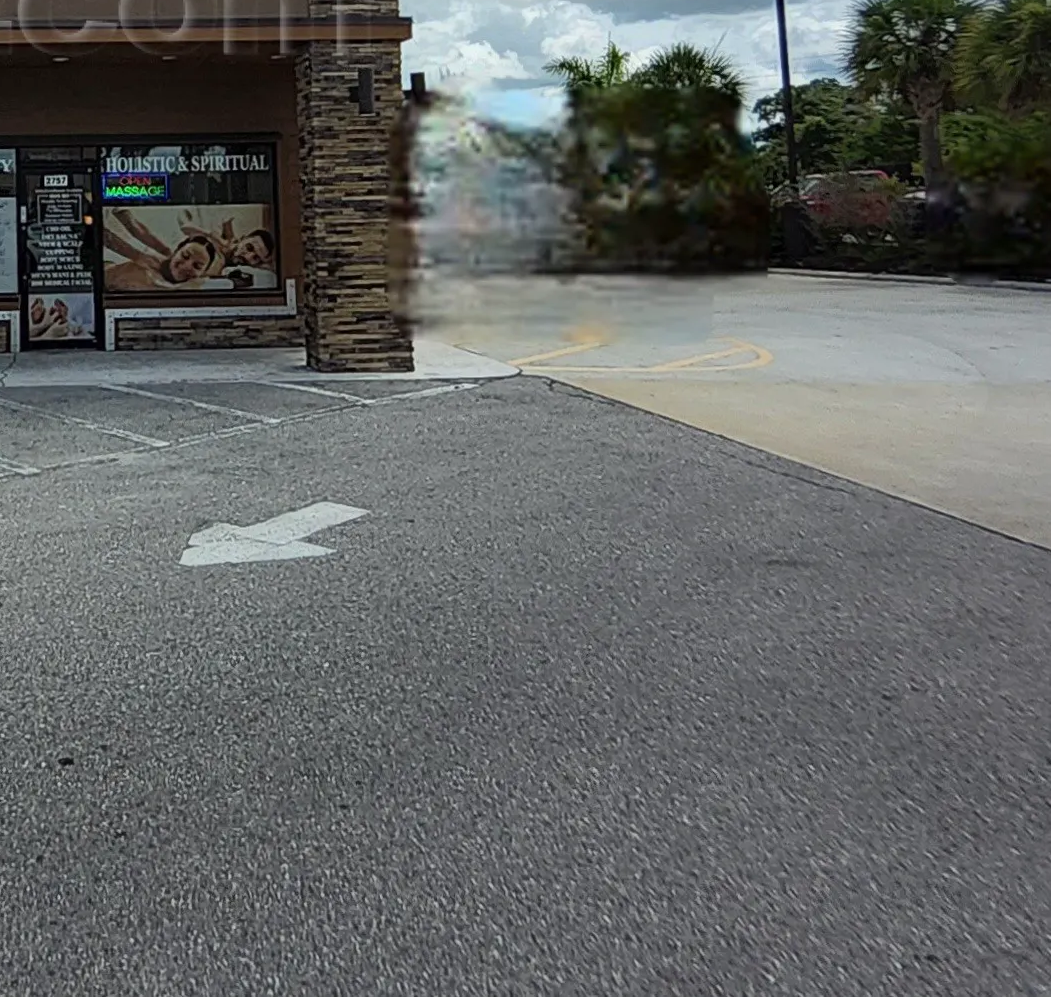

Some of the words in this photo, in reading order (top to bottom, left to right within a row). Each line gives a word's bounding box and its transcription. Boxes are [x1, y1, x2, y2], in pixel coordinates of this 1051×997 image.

[106, 155, 176, 173] HOLISTIC
[177, 157, 189, 173] &
[191, 154, 269, 172] SPIRITUAL
[119, 175, 151, 186] OPEN
[105, 186, 165, 198] MASSAGE
